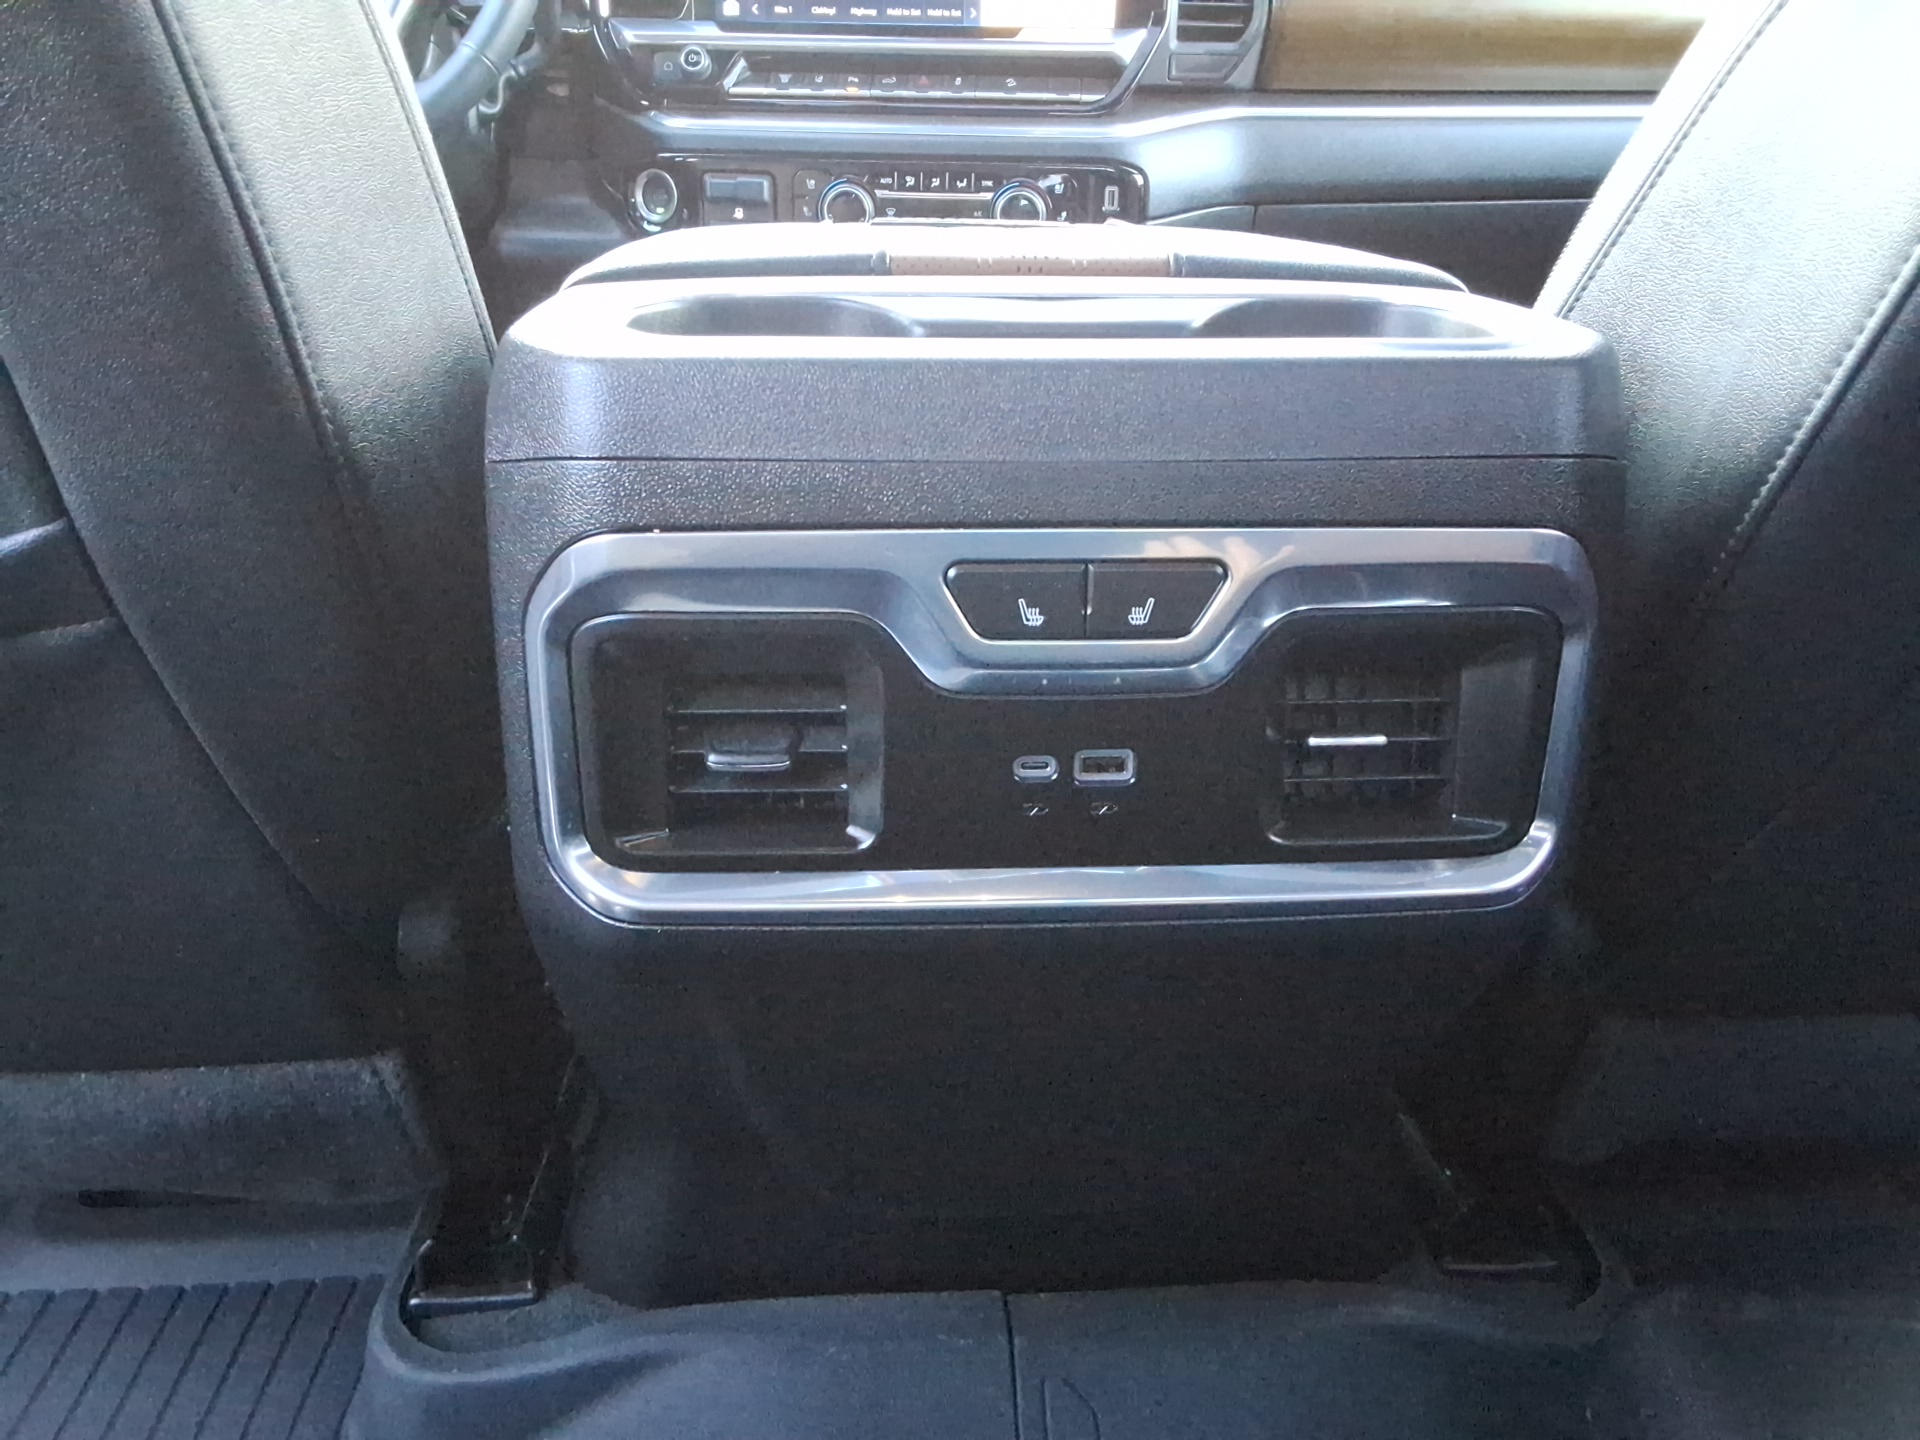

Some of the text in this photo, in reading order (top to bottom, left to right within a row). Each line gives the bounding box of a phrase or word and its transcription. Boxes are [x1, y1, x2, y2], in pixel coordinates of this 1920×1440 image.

[886, 7, 902, 16] Hold
[910, 8, 922, 16] Set
[927, 8, 943, 17] Hold
[950, 8, 962, 17] Set
